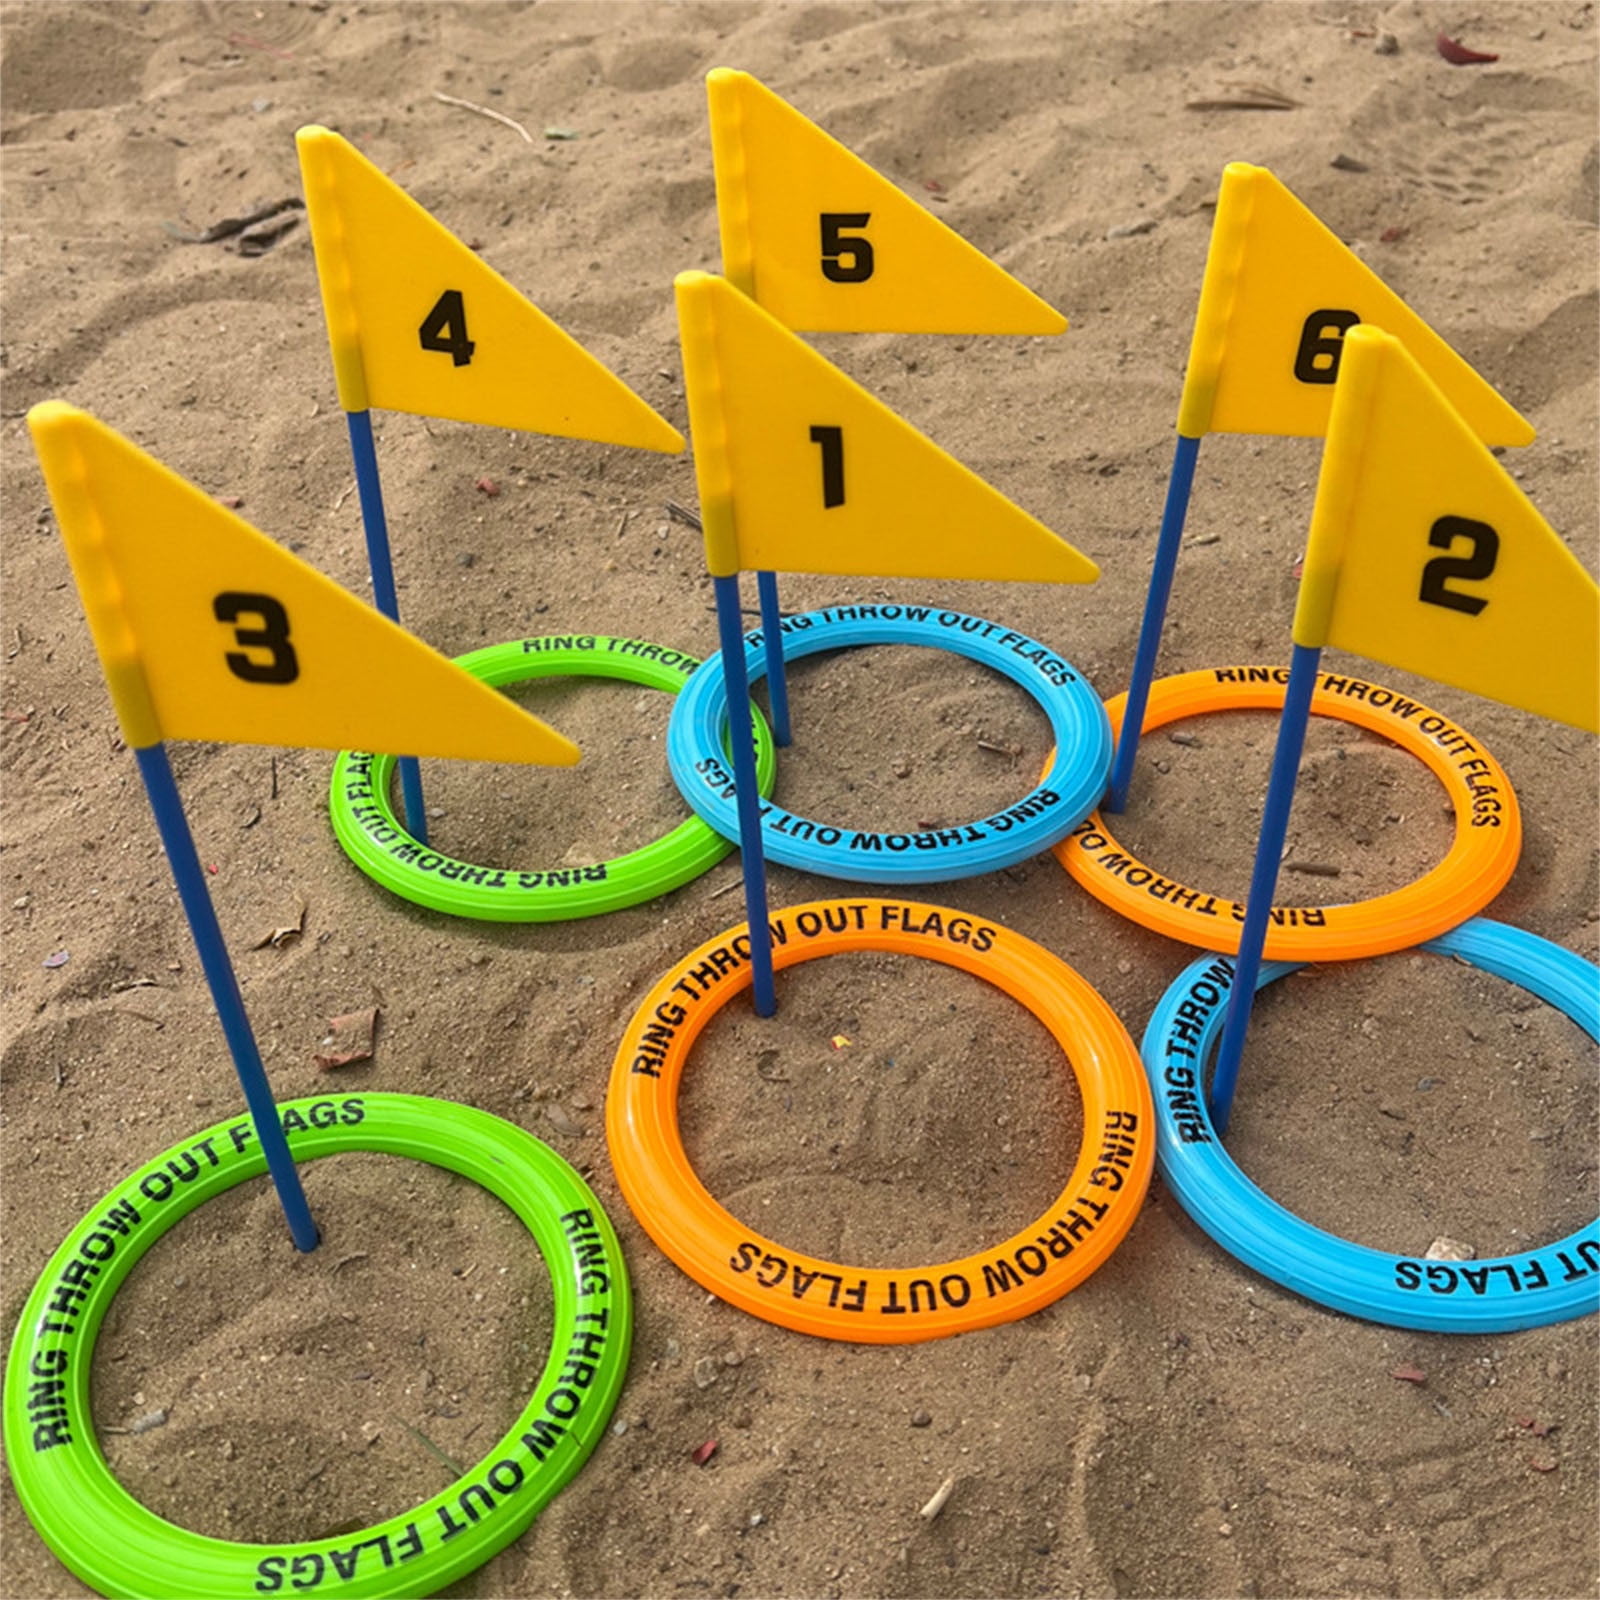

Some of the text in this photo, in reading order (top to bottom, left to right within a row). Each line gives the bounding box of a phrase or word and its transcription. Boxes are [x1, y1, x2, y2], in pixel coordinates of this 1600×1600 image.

[820, 212, 874, 283] 5
[418, 289, 475, 367] 4
[1293, 308, 1361, 385] 6
[809, 425, 846, 509] 1
[1418, 515, 1500, 617] 2
[212, 591, 300, 686] 3
[523, 635, 596, 653] RING
[744, 605, 1077, 687] RNG THROW OUT FLAGS
[1317, 672, 1424, 720] HROW
[1419, 716, 1475, 756] OUT
[1460, 758, 1501, 829] FLAGS
[351, 805, 399, 844] OUT
[769, 814, 843, 846] OUT
[850, 823, 987, 852] THROW
[990, 788, 1061, 832] RING
[389, 843, 507, 889] THROW
[518, 863, 608, 889] RING
[1098, 853, 1217, 916] THROW
[632, 1000, 687, 1079] RING
[796, 904, 869, 938] OUT
[879, 904, 998, 953] FLAGS
[1166, 957, 1236, 1145] RING THROW
[729, 1110, 1139, 1314] RING THROW OUT FLAGS
[28, 1098, 365, 1453] RING THROW OUT FAGS
[1394, 1240, 1600, 1296] UT FLAGS
[254, 1207, 612, 1595] RING THROW OUT FLAGS
